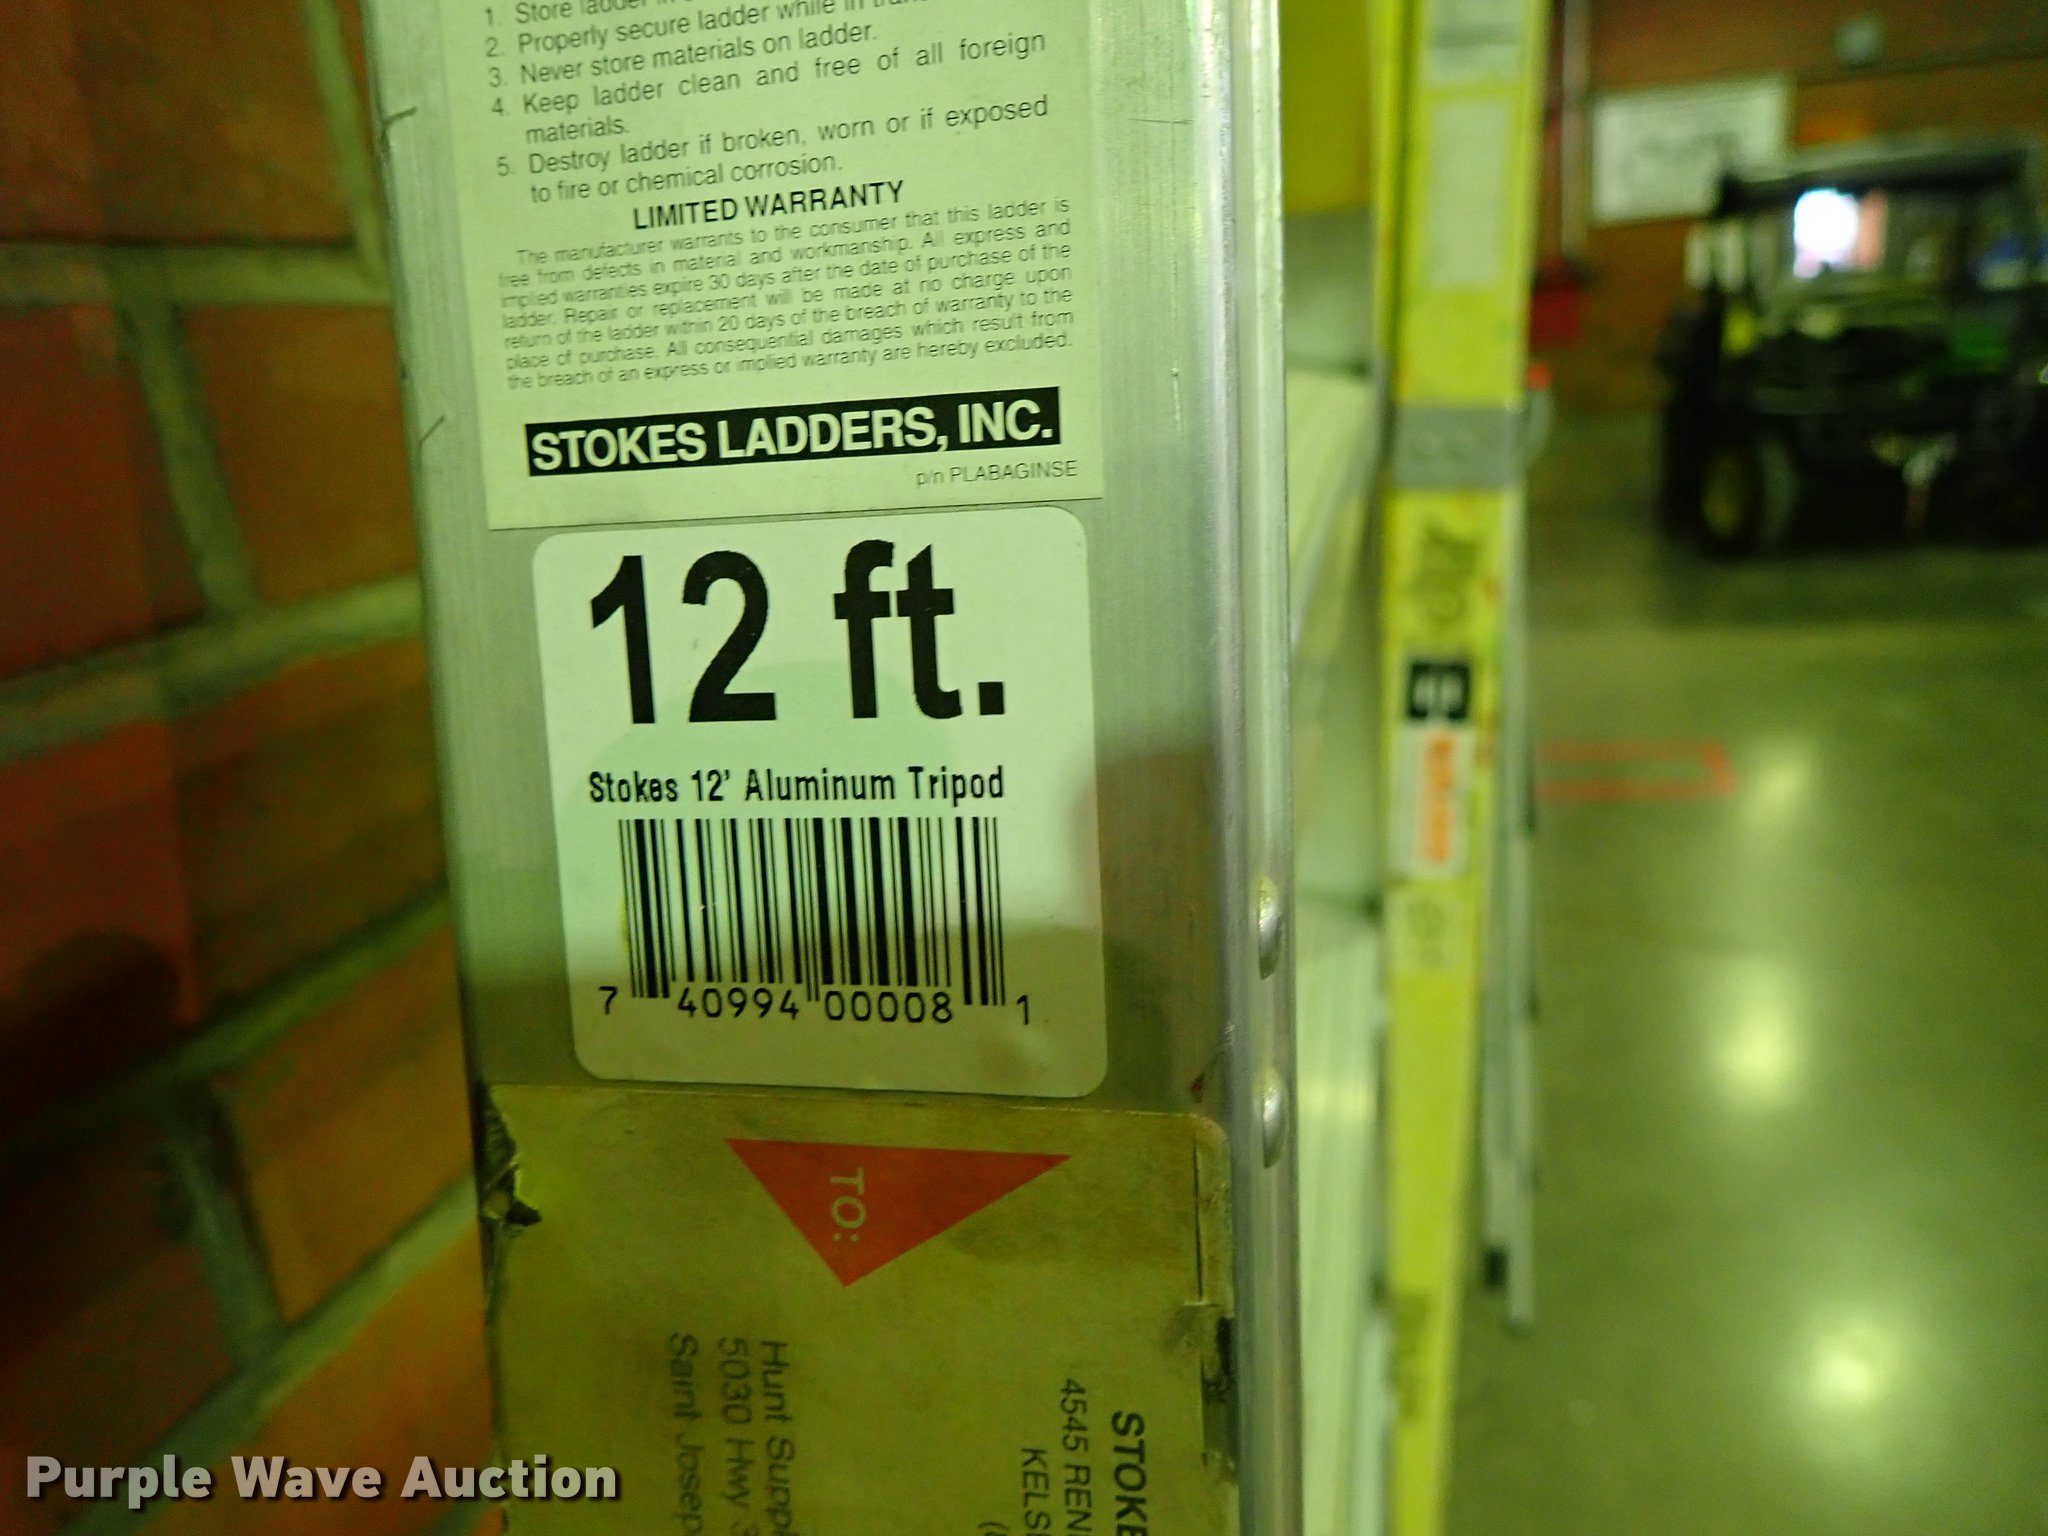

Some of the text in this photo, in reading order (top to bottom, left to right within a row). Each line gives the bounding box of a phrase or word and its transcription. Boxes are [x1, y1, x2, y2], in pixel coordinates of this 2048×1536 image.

[484, 7, 502, 26] 1.
[515, 1, 572, 25] Store
[486, 37, 505, 58] 2.
[519, 24, 608, 54] Properly
[615, 16, 691, 41] secure
[697, 4, 770, 31] ladder
[776, 0, 836, 20] while
[489, 22, 878, 88] 3. Never store materials on ladder.
[491, 32, 1047, 116] 4. Keep ladder clean and free of all foreign
[496, 155, 516, 177] 5.
[528, 149, 610, 175] Destroy
[620, 138, 690, 165] ladder
[699, 132, 712, 155] if
[817, 118, 875, 142] worn
[885, 113, 910, 134] or
[920, 107, 934, 131] if
[944, 94, 1049, 130] exposed
[525, 115, 630, 145] materials.
[530, 153, 843, 204] to fire or chemical corrosion.
[632, 179, 904, 231] LIMITED WARRANTY
[498, 218, 1070, 288] free from defects in material and workmanship. All express and
[516, 196, 1070, 265] The manufacturer warrants to the consumer that this ladder is
[501, 243, 1072, 309] implied warranties expire 30 days after the date of purchase of the
[563, 305, 617, 325] Repair
[626, 306, 643, 319] or
[653, 293, 757, 318] replacement
[765, 288, 793, 305] will
[801, 287, 824, 303] be
[833, 282, 883, 300] made
[892, 279, 911, 296] at
[920, 278, 942, 292] no
[952, 271, 1016, 290] charge
[1026, 266, 1072, 287] upon
[505, 287, 1073, 349] return of the ladder within 20 days of the breach of warranty to the
[506, 354, 550, 371] place
[556, 349, 572, 365] of
[666, 340, 688, 357] All
[694, 329, 814, 355] consequential
[821, 325, 903, 345] damages
[911, 317, 964, 337] which
[972, 312, 1024, 332] result
[1031, 309, 1074, 328] from
[507, 331, 1072, 390] the breach of an express or implied warranty are hereby excluded.
[531, 399, 1053, 471] STOKES LADDERS, INC.
[915, 459, 1079, 488] p/n PLABAGINSE
[590, 539, 1006, 724] 12 ft.
[589, 765, 1003, 808] Stokes 12' Aluminum Tripod
[598, 986, 1030, 1025] 7 40994 00008 1
[828, 1167, 867, 1244] TO:
[669, 1331, 703, 1421] Saint
[718, 1336, 754, 1425] 5030
[761, 1339, 793, 1423] Hunt
[719, 1437, 757, 1509] Hwy
[1060, 1378, 1093, 1536] 4545 REN
[1021, 1448, 1052, 1536] KELS
